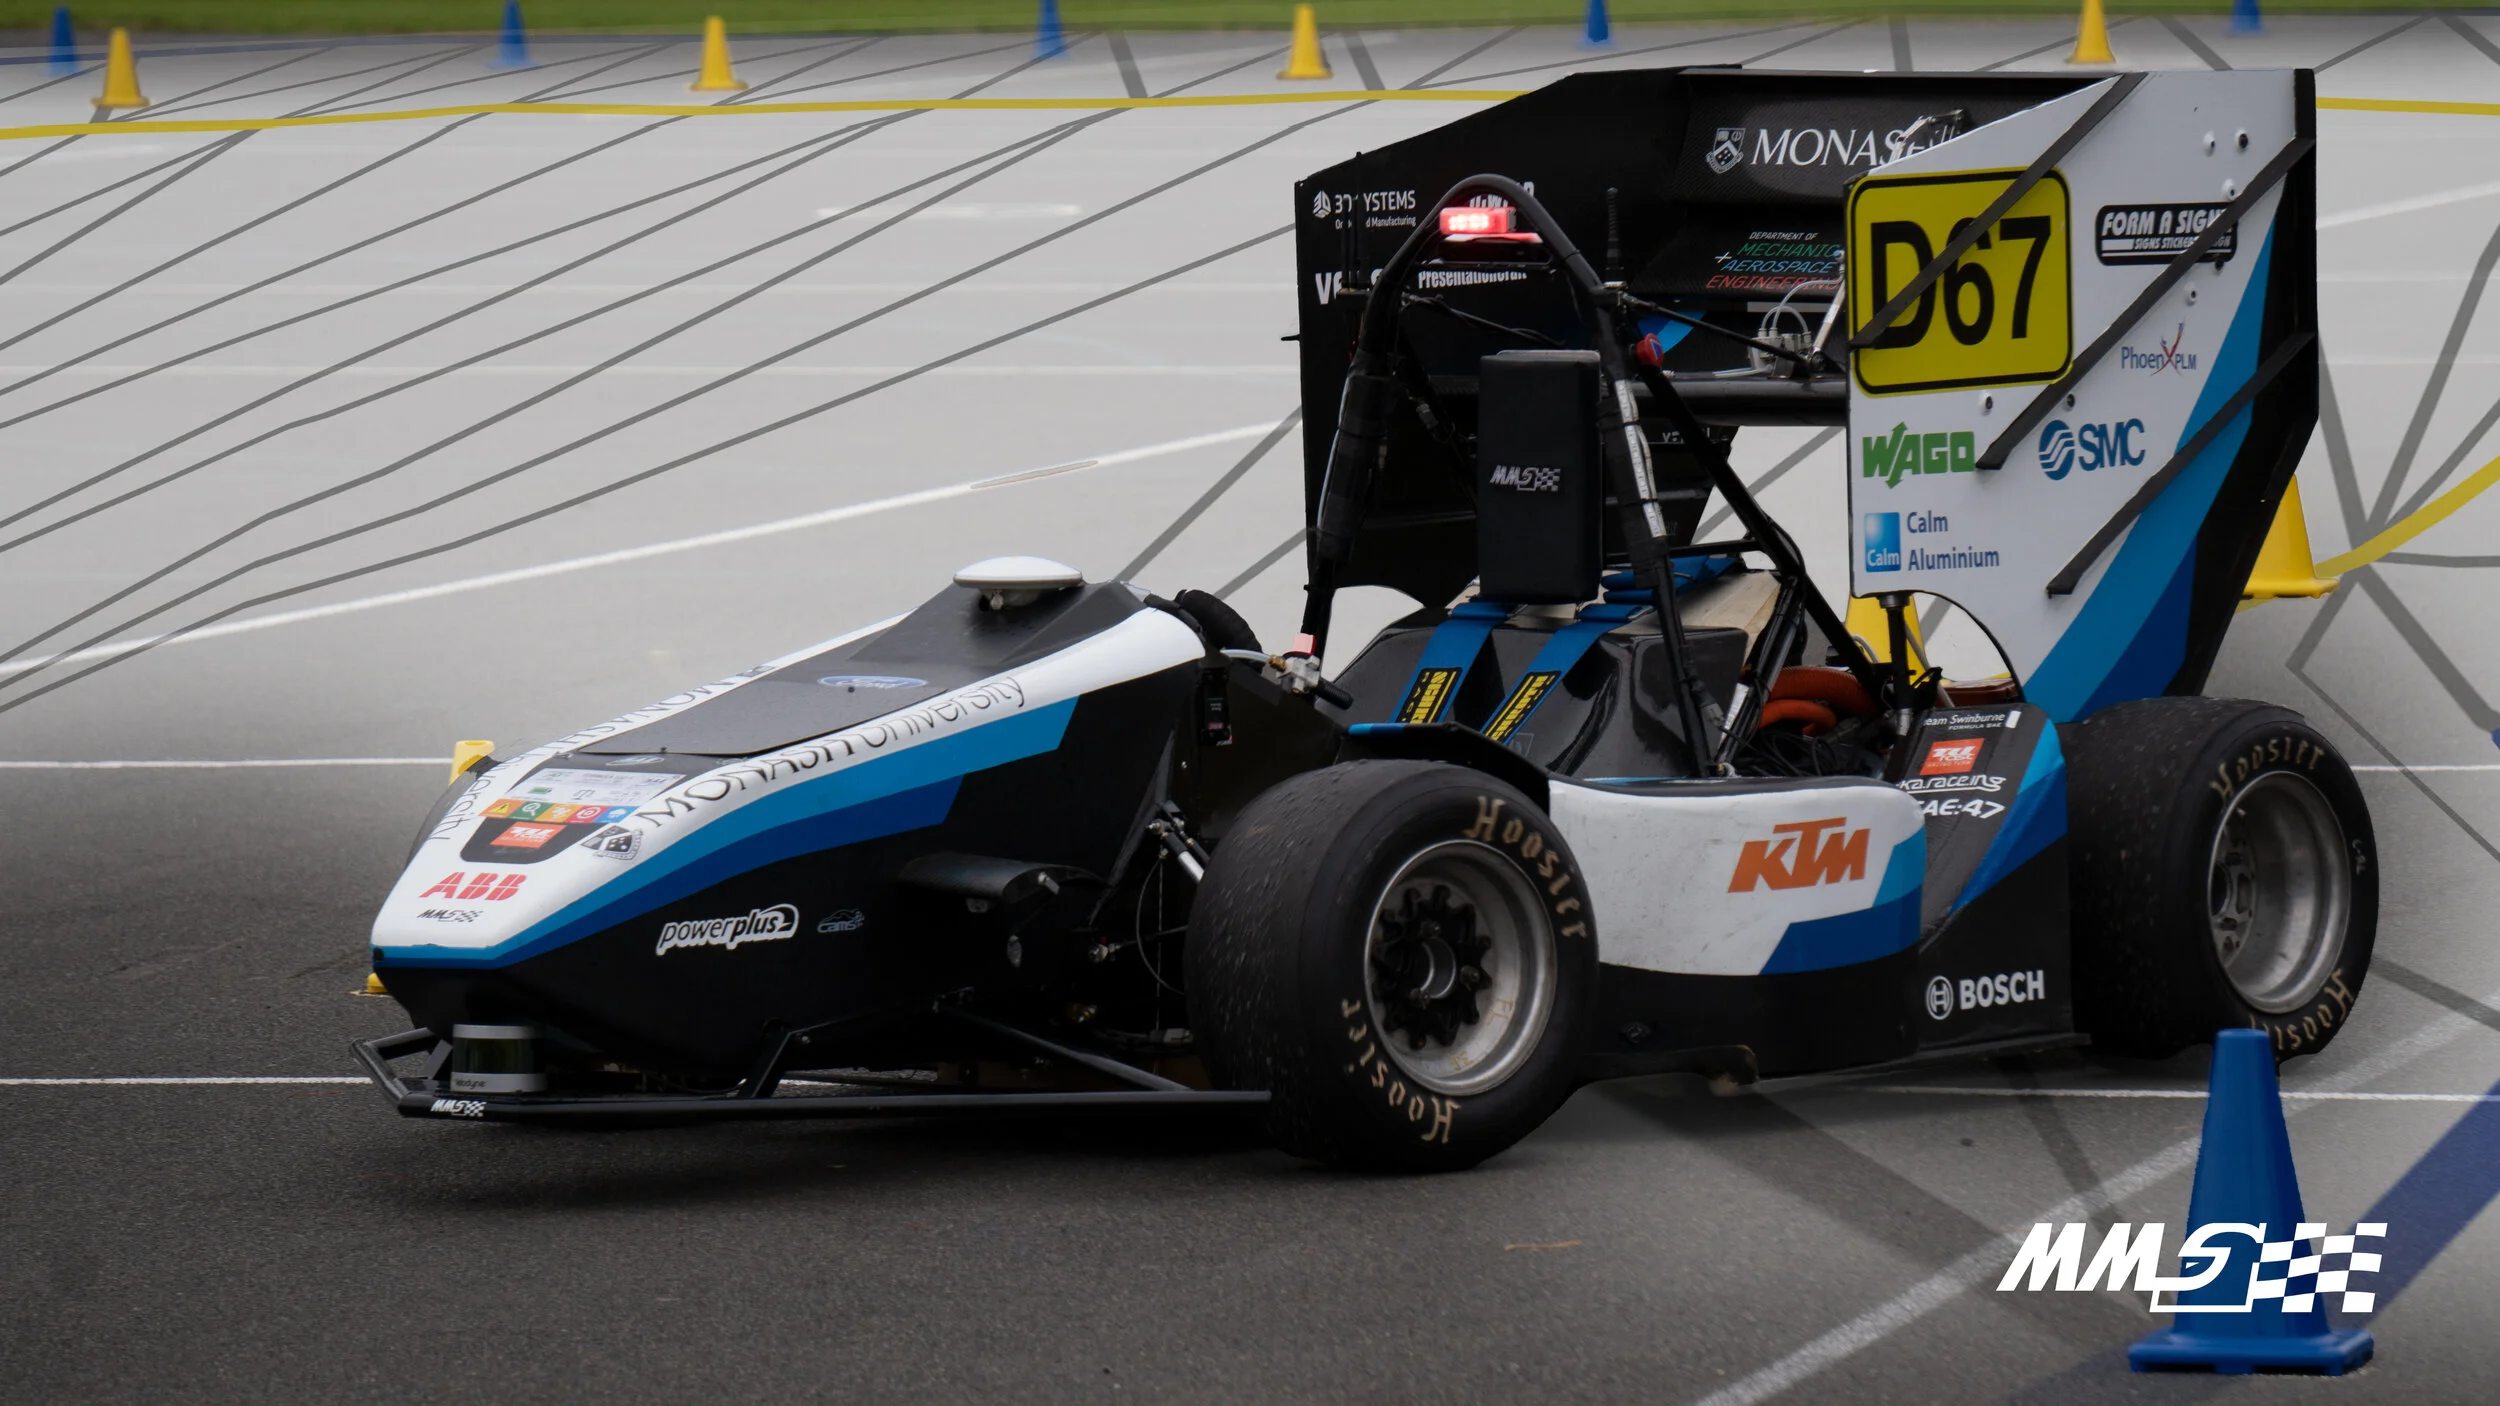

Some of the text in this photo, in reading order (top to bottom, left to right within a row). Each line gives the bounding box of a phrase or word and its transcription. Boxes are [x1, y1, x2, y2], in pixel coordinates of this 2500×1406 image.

[1353, 190, 1417, 213] YSTEMS
[1749, 231, 1819, 241] DEPARTMENT OF
[2101, 210, 2156, 236] FORM
[2158, 210, 2173, 235] A
[2134, 237, 2161, 250] SIGNS
[1719, 259, 1838, 274] AEROSPACE
[1871, 216, 2052, 350] D67
[1863, 425, 1976, 485] WAGO
[2078, 418, 2147, 471] SMC
[1490, 465, 1538, 491] MMS
[1907, 510, 1948, 534] Calm
[1866, 548, 1900, 567] Calm
[1908, 546, 2000, 571] Aluminium
[1923, 713, 2006, 726] eam Swinburne
[636, 734, 856, 828] MONASH
[856, 675, 1026, 748] University
[2209, 735, 2326, 804] Hoosier
[1463, 794, 1589, 939] Hoosier
[1728, 816, 1871, 893] KTM
[418, 871, 528, 901] ABB
[656, 906, 786, 953] powerplus
[1958, 968, 2046, 1011] BOSCH
[2249, 967, 2355, 1051] Hoosi
[1341, 997, 1463, 1146] Hoosier
